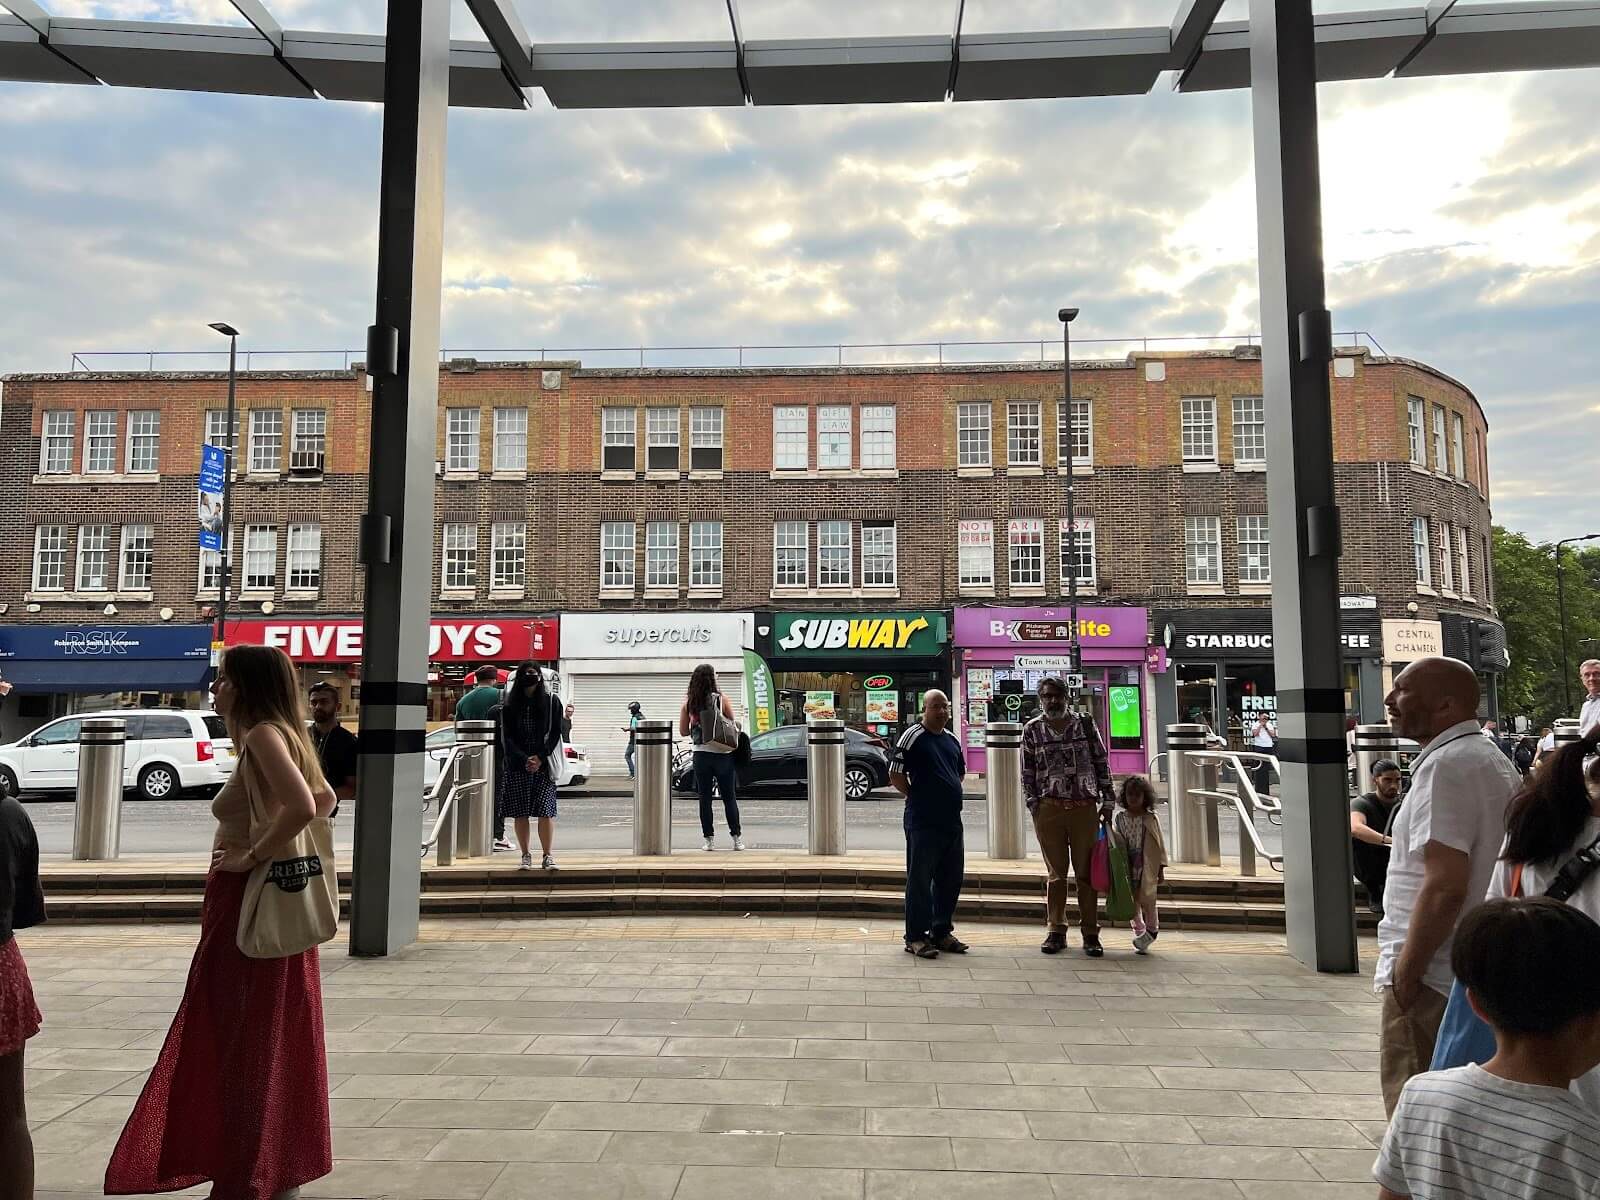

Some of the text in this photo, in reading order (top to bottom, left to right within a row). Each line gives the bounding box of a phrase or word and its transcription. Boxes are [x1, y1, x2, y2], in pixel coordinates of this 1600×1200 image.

[605, 625, 712, 647] supercuts
[778, 616, 929, 651] SUBWAY
[1075, 619, 1112, 637] ite
[1397, 630, 1435, 640] CENTRAL
[54, 639, 85, 647] Robertson
[86, 639, 104, 647] Smith
[65, 631, 128, 655] RSK
[264, 624, 503, 657] FIVE YS
[1186, 634, 1370, 648] STARBUC FEE
[1394, 643, 1437, 654] CHAMBERS
[867, 678, 889, 687] OPEN
